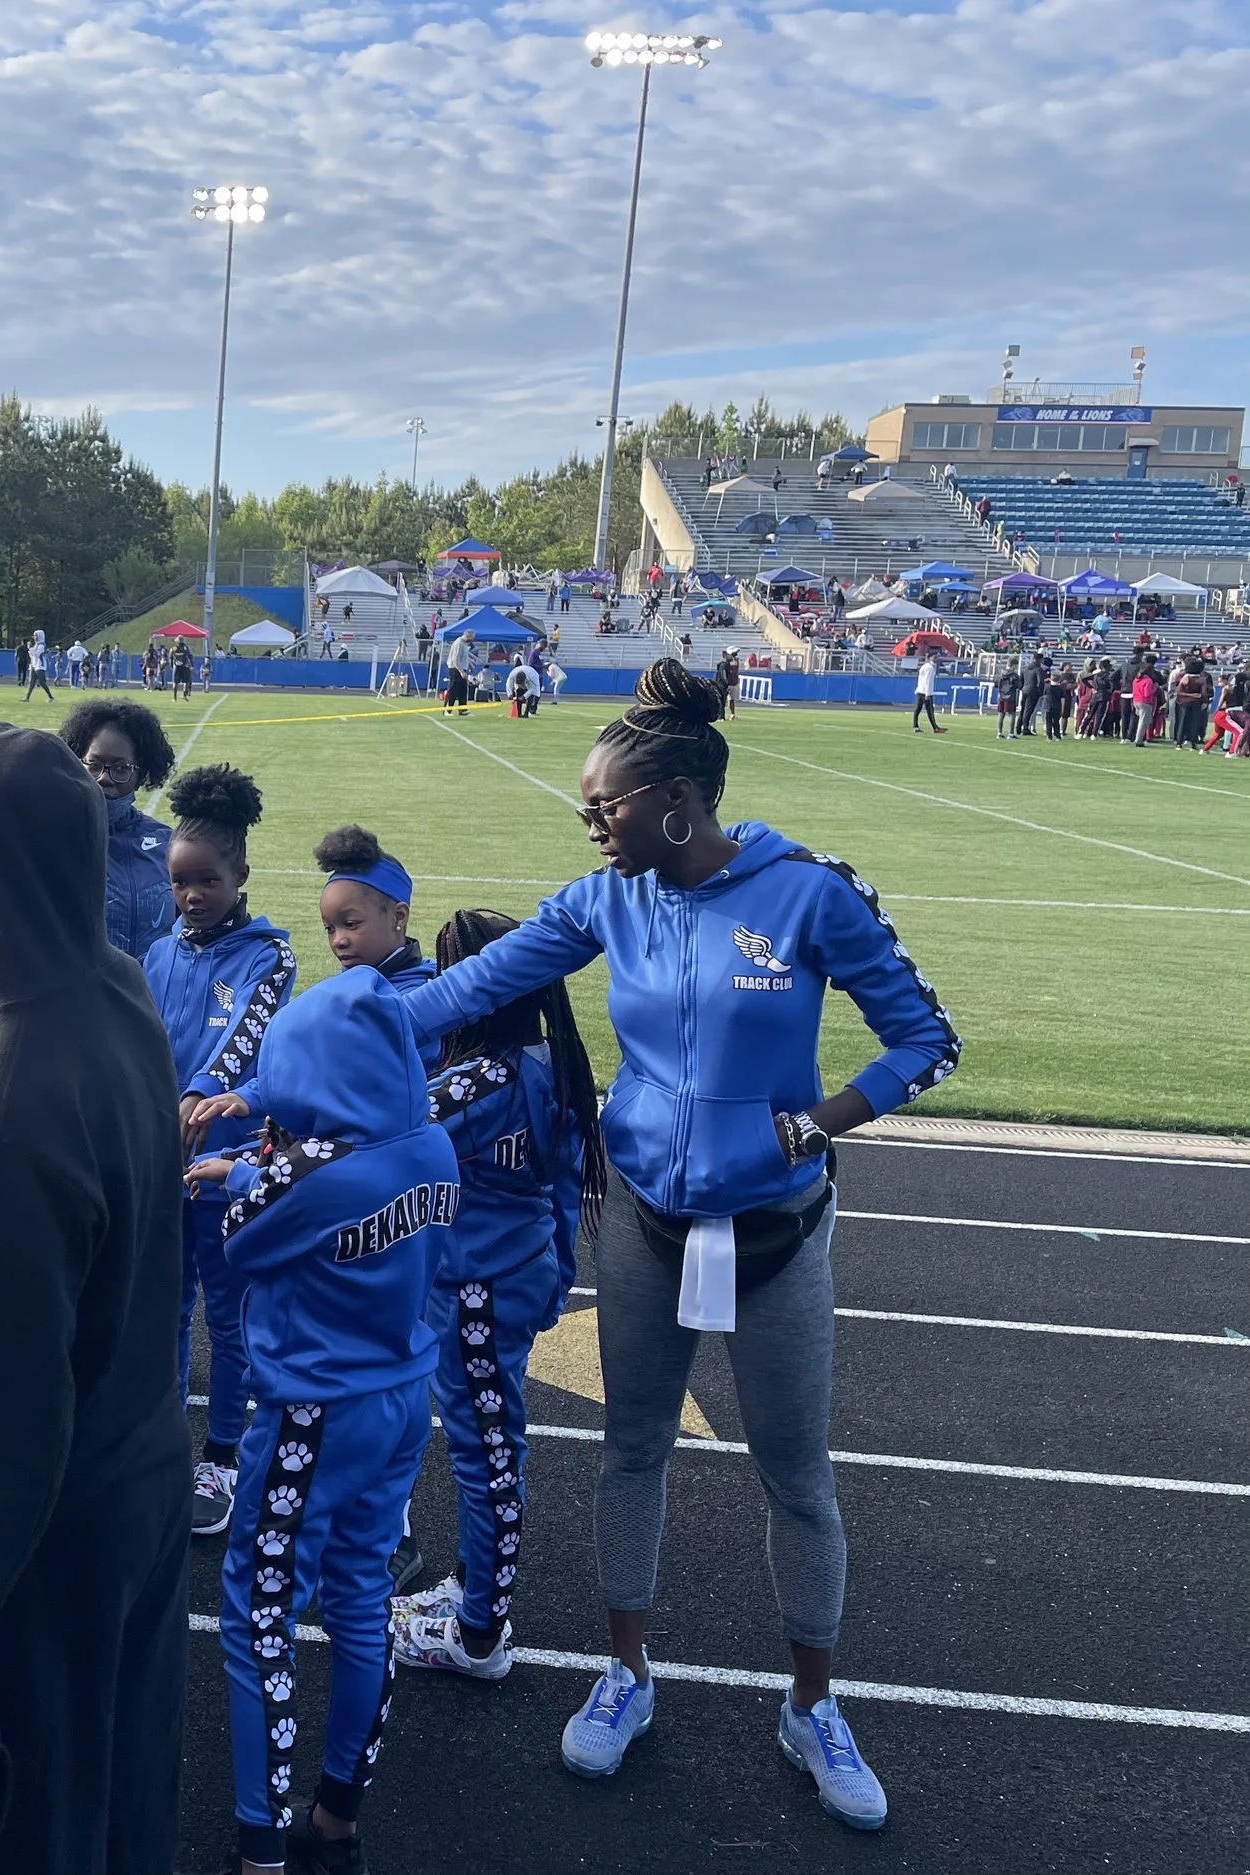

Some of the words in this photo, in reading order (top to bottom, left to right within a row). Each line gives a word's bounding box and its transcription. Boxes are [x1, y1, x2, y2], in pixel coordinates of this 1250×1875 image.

[1035, 409, 1068, 420] HOME
[1081, 409, 1114, 421] LIONS
[732, 975, 771, 990] TRACK
[335, 1183, 431, 1262] DEKALB
